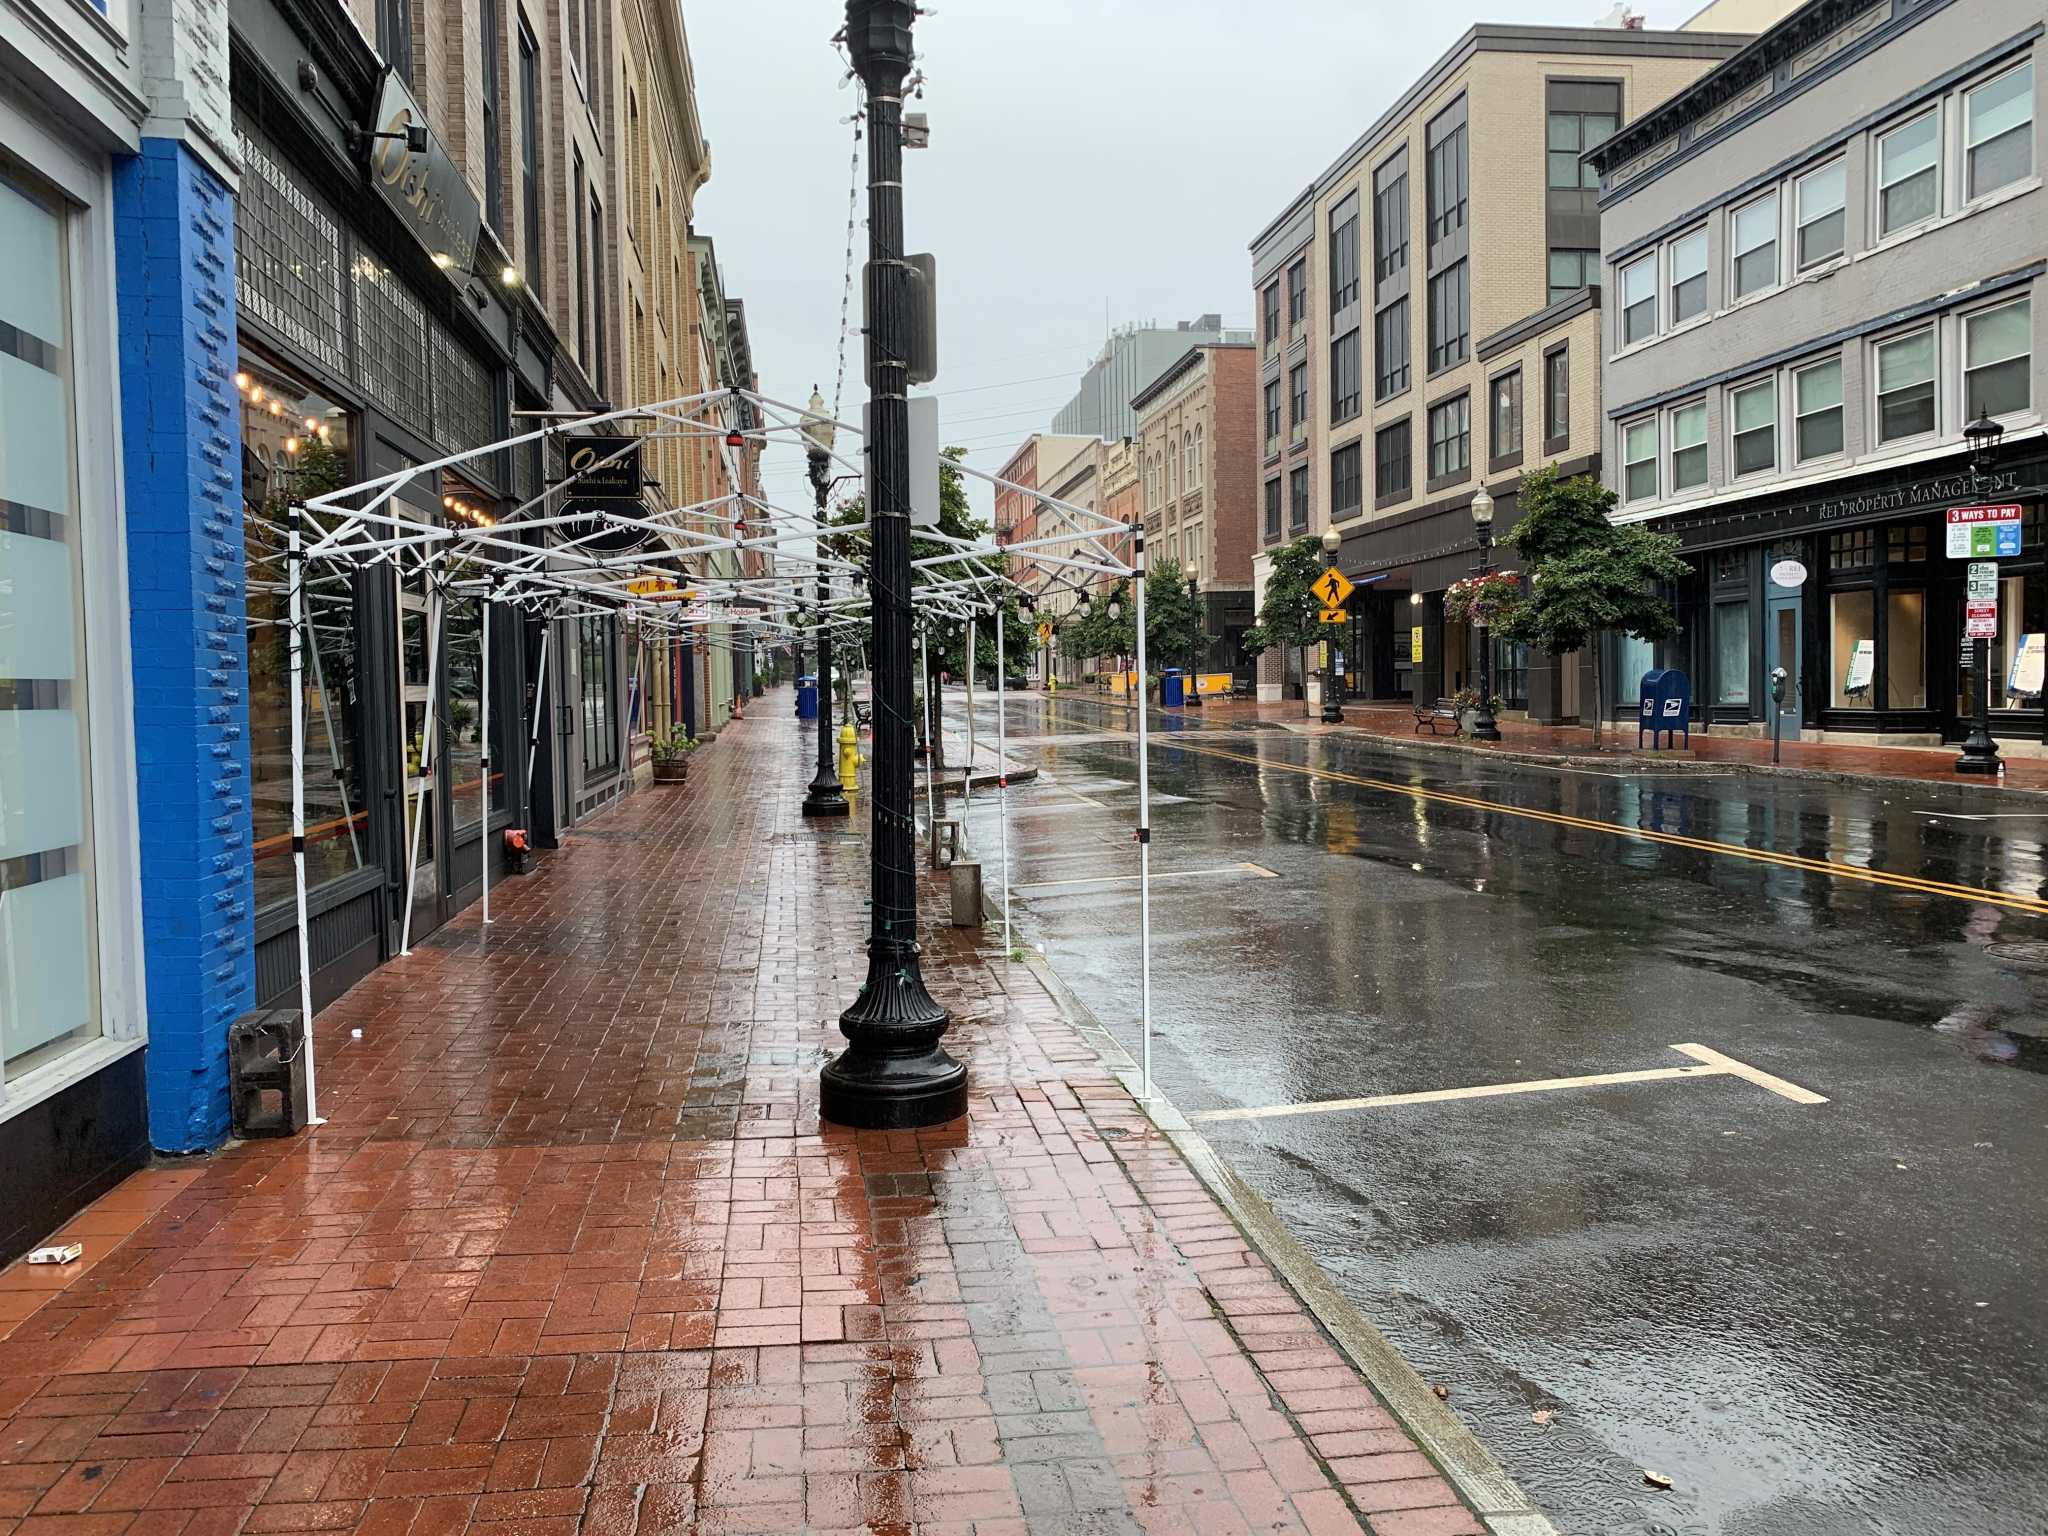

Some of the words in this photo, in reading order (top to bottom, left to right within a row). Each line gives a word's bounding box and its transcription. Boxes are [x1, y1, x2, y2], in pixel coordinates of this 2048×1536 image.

[1841, 492, 1905, 516] PROPERTY
[1909, 471, 2017, 503] MANAGENT
[1951, 510, 1960, 522] 3
[1961, 510, 1984, 520] WAYS
[1987, 509, 1997, 519] TO
[2000, 507, 2016, 518] PAY
[1970, 565, 1977, 574] 2
[1970, 582, 1977, 590] 3
